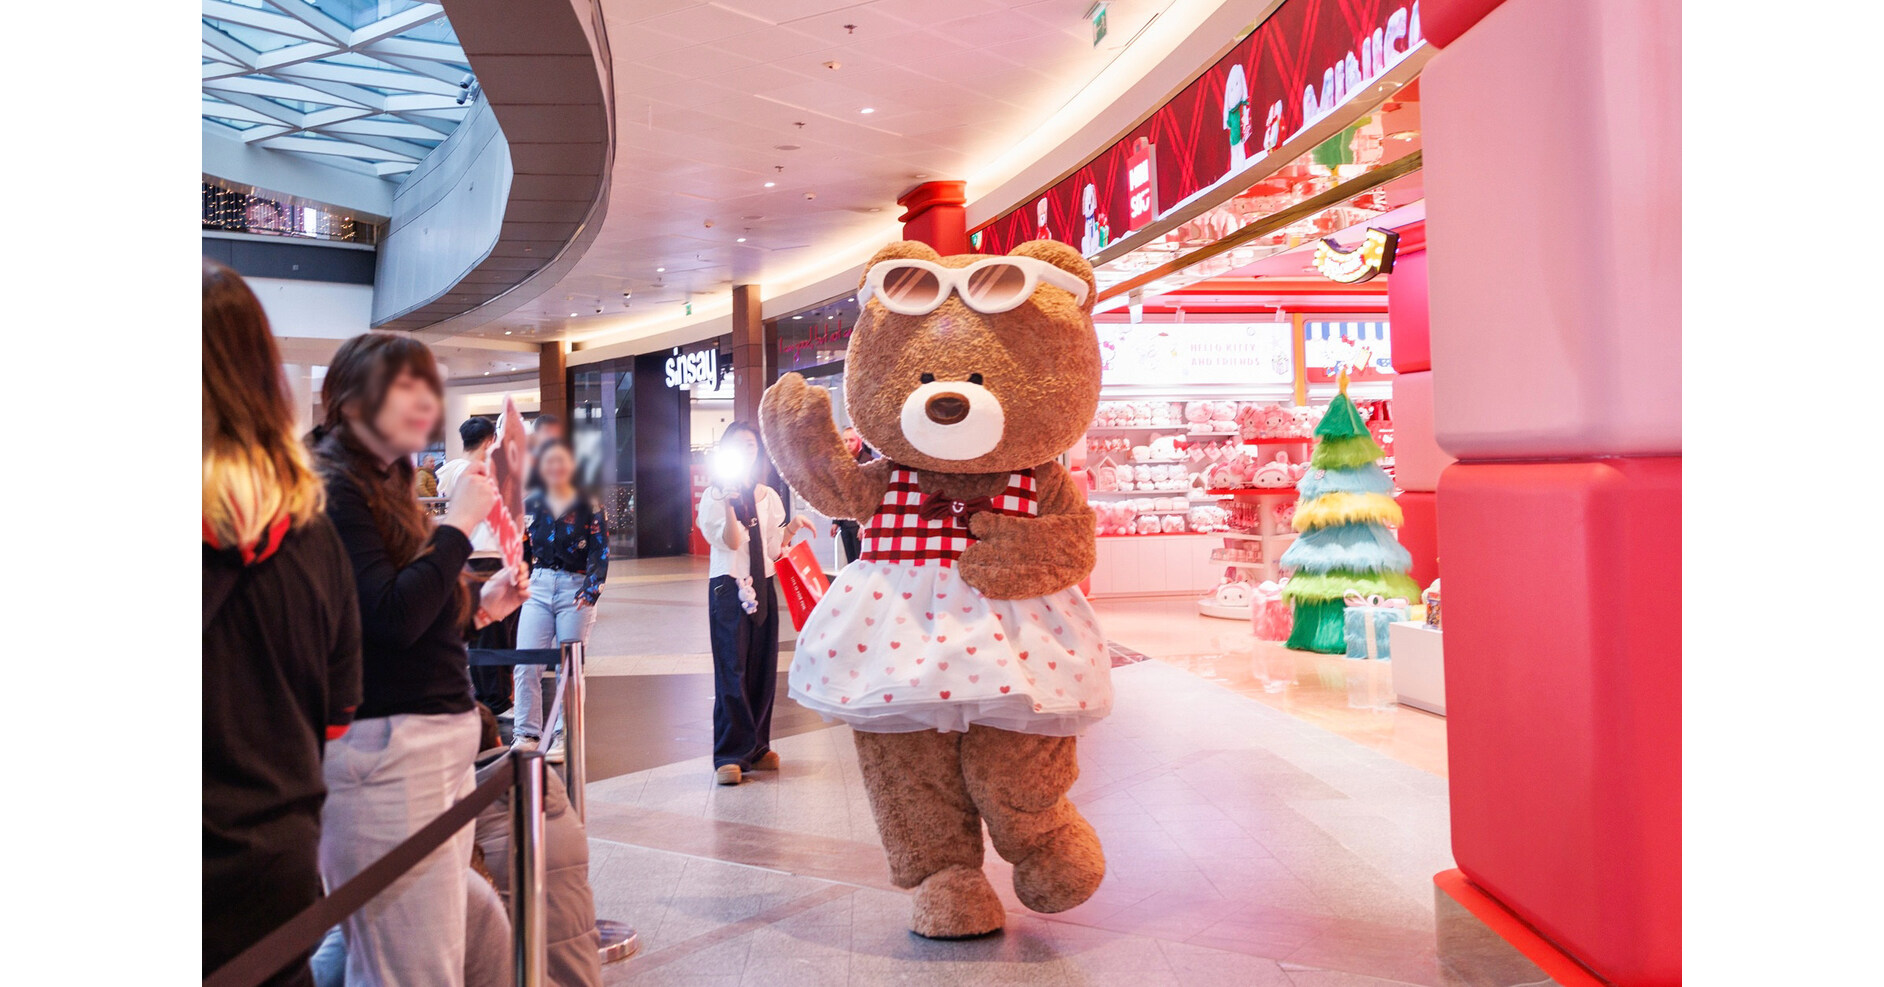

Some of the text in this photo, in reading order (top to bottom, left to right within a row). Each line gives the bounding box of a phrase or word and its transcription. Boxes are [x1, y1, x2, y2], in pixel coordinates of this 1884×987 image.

[1303, 0, 1421, 125] MINIS
[1190, 343, 1256, 352] HELLO KITTY
[665, 347, 717, 391] sinsay
[1191, 357, 1260, 366] AND FRIENDS
